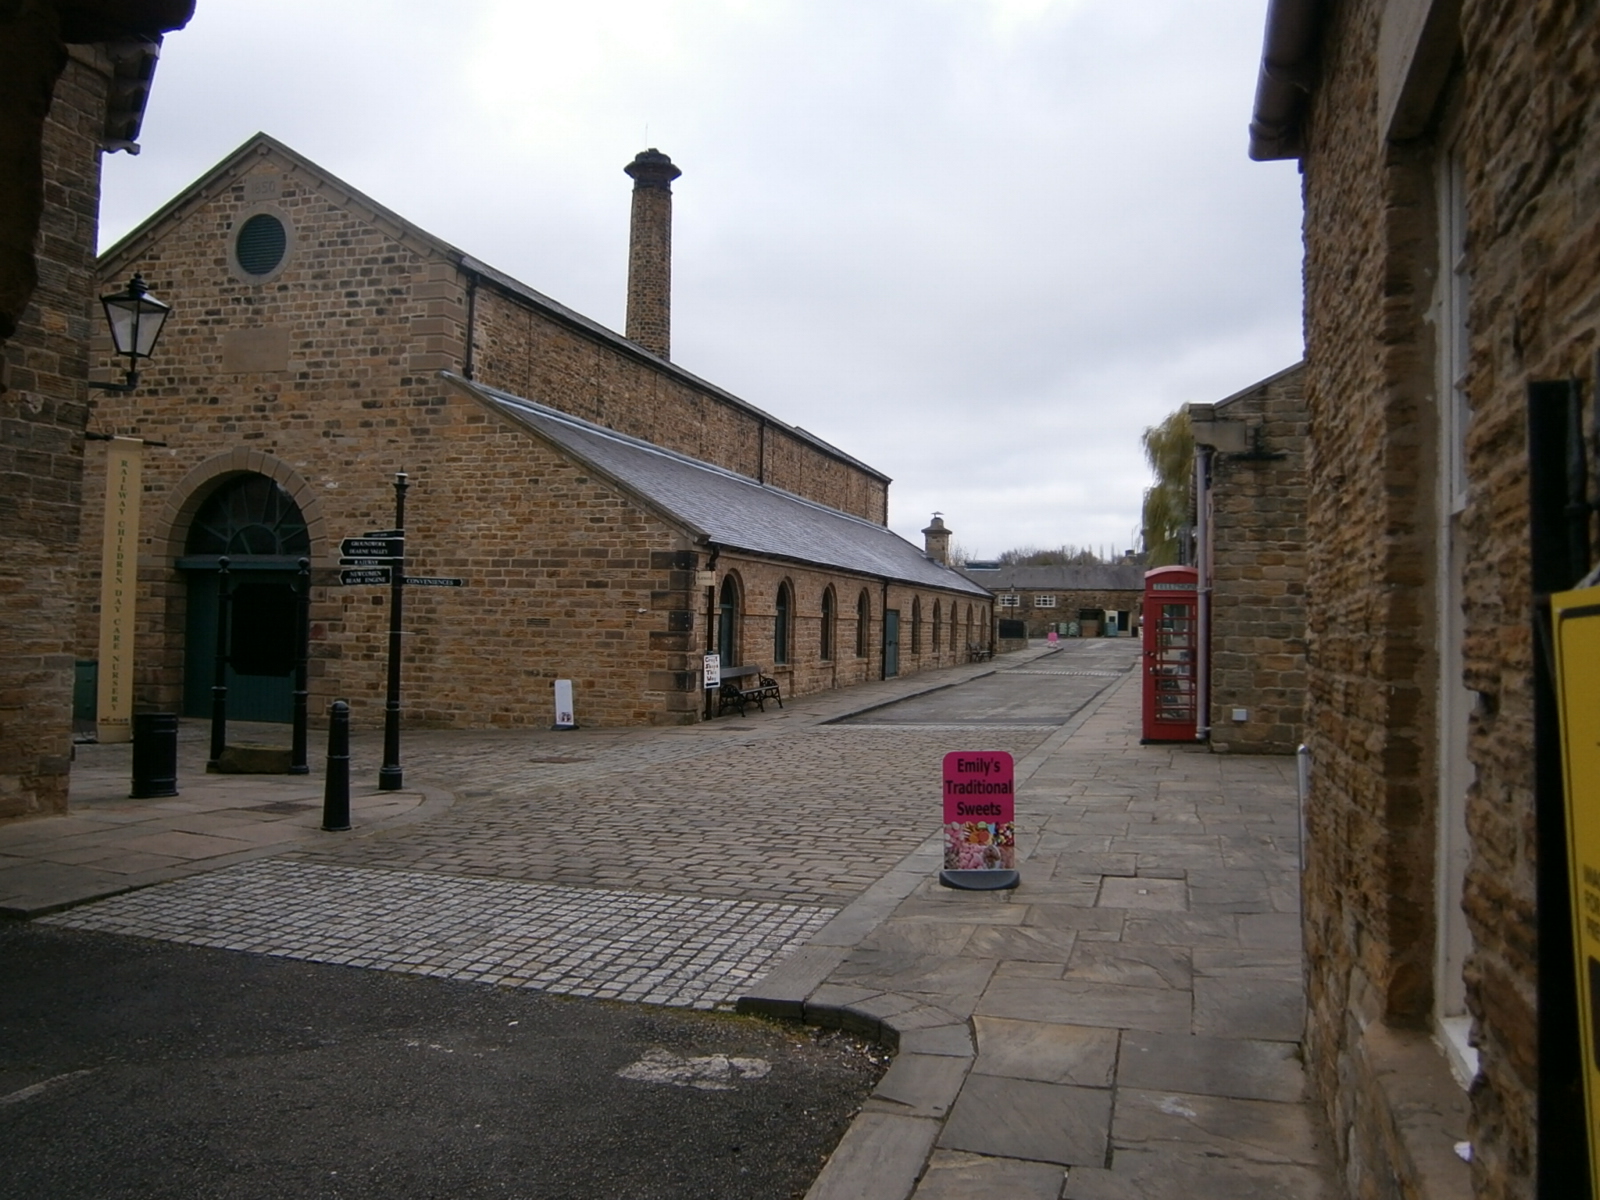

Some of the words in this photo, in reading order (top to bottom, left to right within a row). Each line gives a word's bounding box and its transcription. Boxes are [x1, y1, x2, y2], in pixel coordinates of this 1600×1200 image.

[251, 180, 276, 194] 1850
[118, 460, 128, 515] RAILWAY
[116, 520, 125, 584] CHILDREN
[114, 589, 122, 613] DAY
[113, 619, 121, 650] CARE
[111, 655, 120, 711] NURSERY
[957, 758, 1001, 776] Emily's
[945, 779, 1012, 795] Traditional
[957, 801, 1002, 816] Sweets
